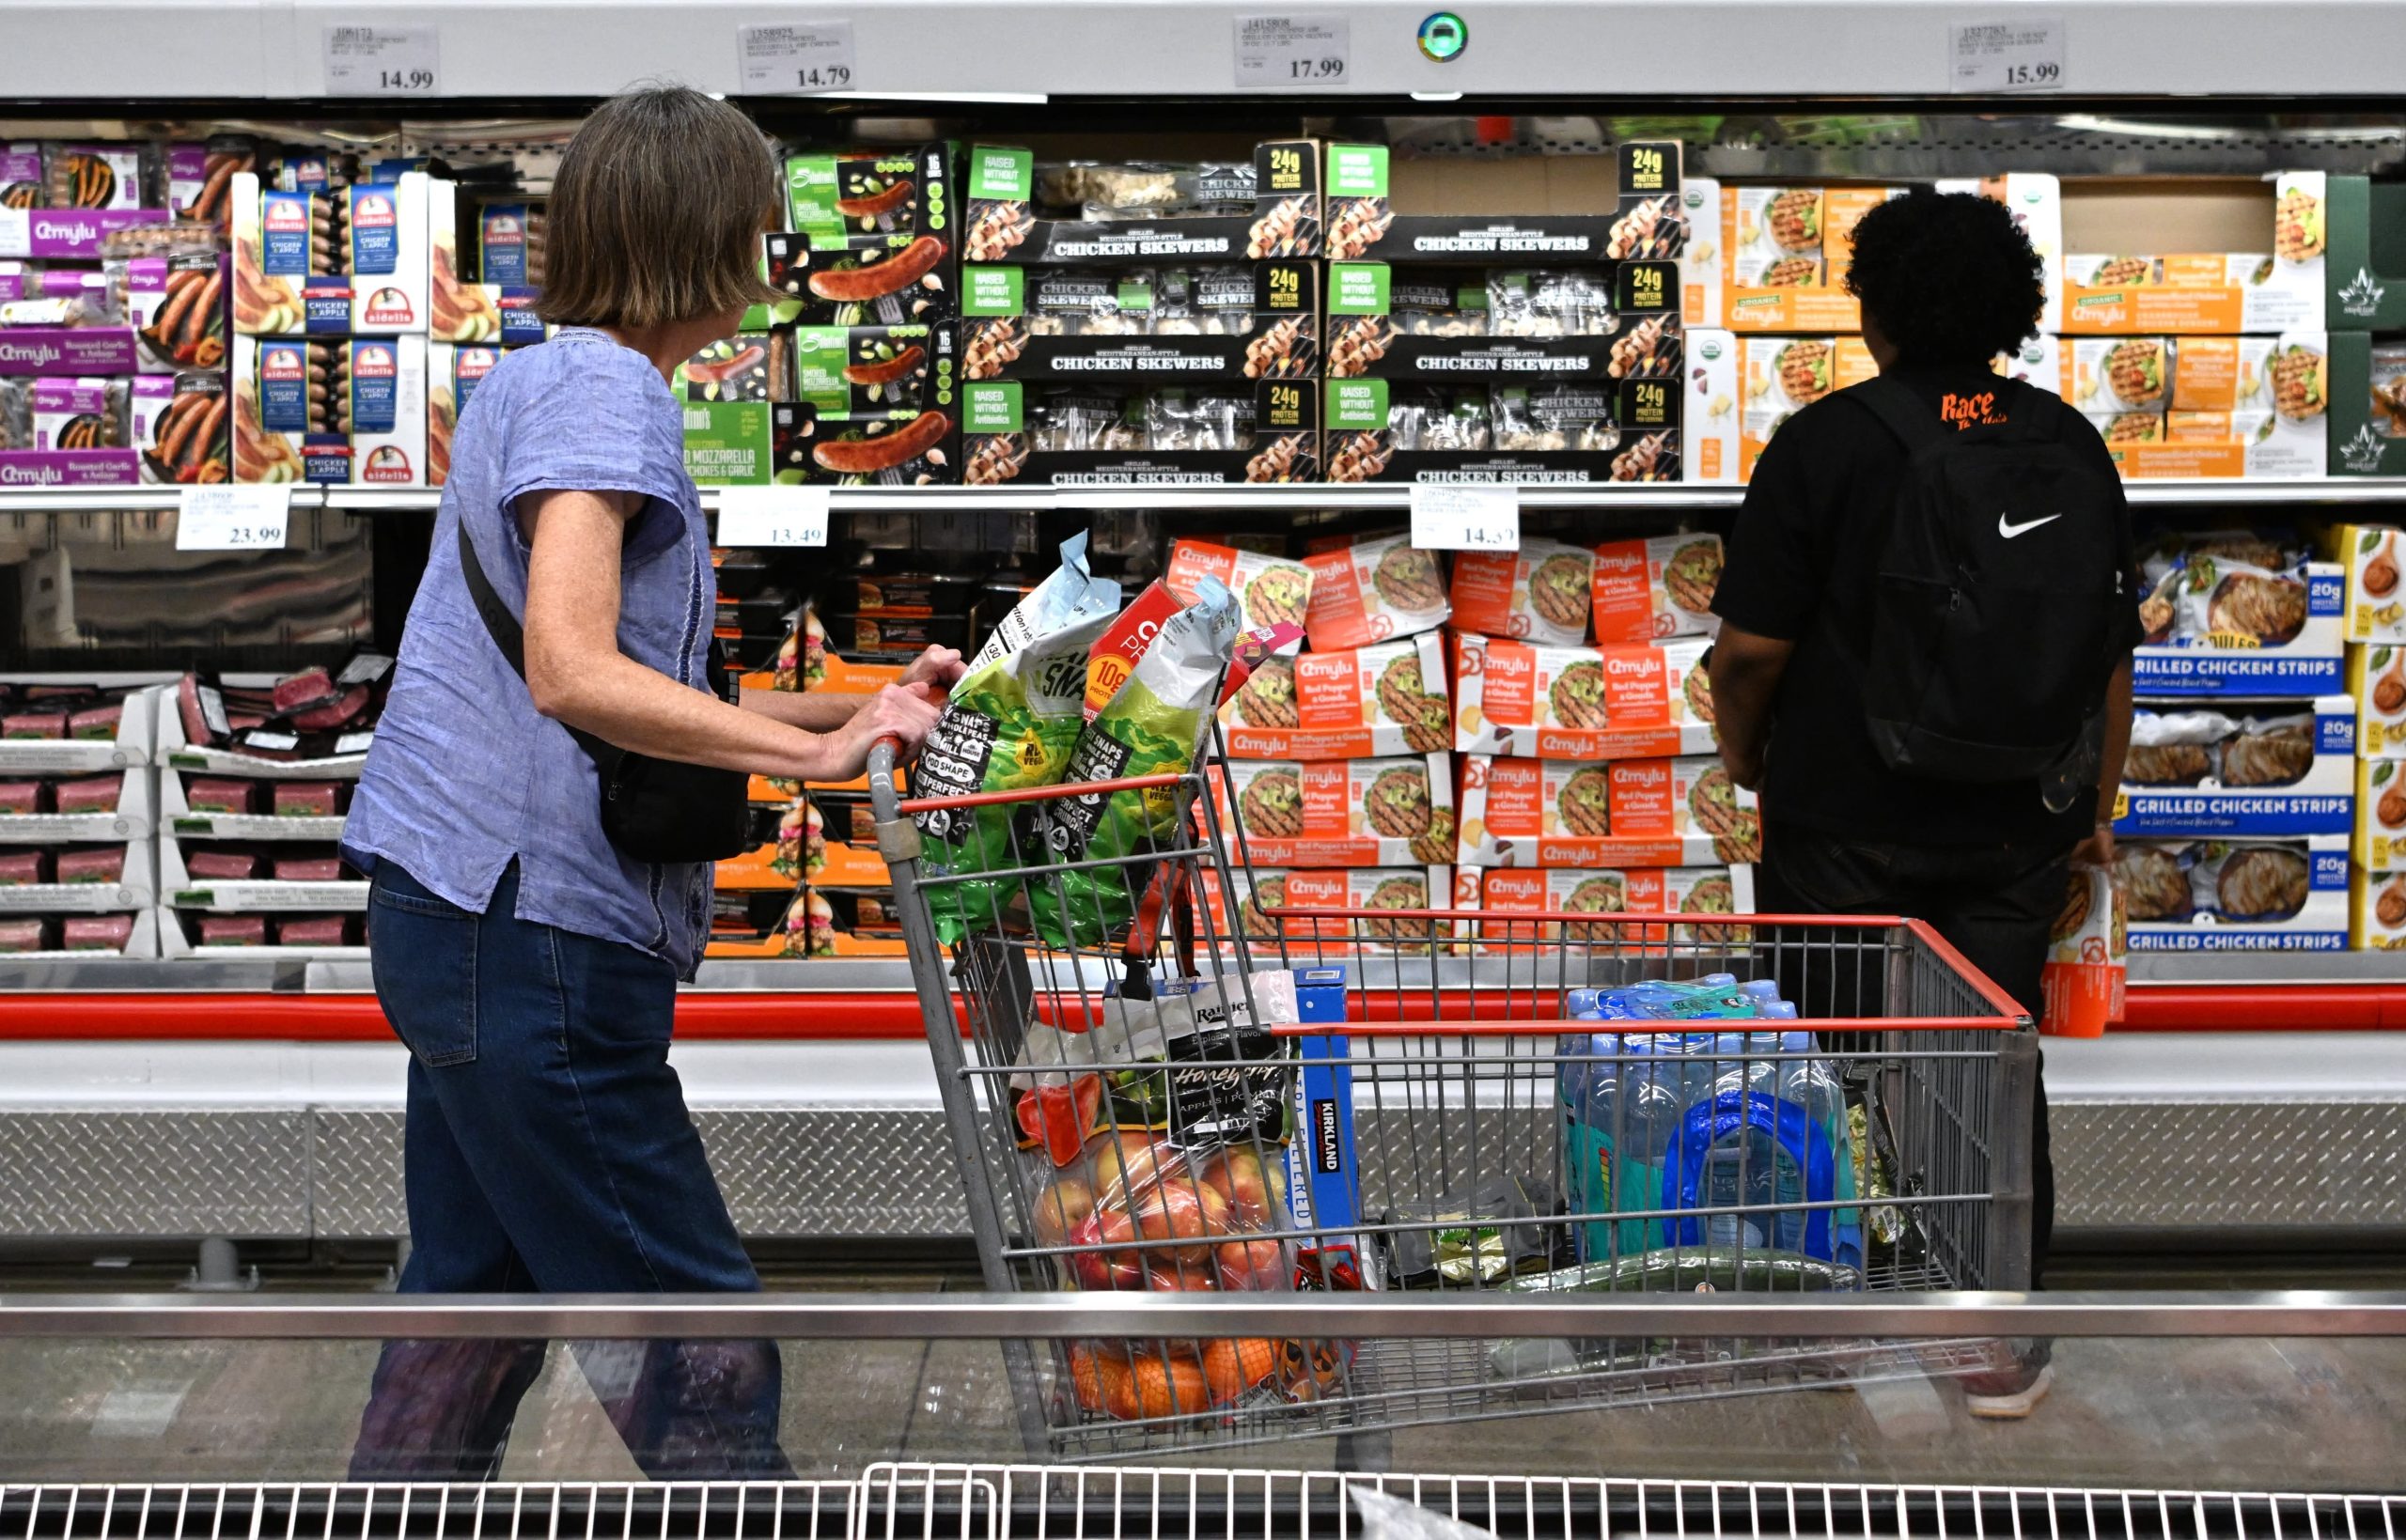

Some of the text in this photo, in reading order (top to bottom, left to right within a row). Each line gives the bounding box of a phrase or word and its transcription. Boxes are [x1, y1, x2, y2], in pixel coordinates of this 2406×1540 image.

[1289, 59, 1344, 78] 17.99
[2007, 64, 2060, 84] 15.99
[381, 70, 434, 88] 14.99
[797, 67, 851, 86] 14.79
[928, 156, 940, 170] 16
[985, 157, 1015, 168] RAISED
[1271, 150, 1300, 173] 24g
[1633, 149, 1663, 172] 24g
[984, 169, 1019, 180] WITHOUT
[1273, 175, 1300, 183] PROTEIN
[1633, 174, 1662, 182] PROTEIN
[1055, 238, 1229, 257] CHICKEN SKEWERS
[1414, 237, 1589, 252] CHICKEN SKEWERS
[1270, 270, 1298, 291] 24g
[1633, 268, 1662, 290] 24g
[975, 286, 1010, 296] WITHOUT
[1040, 284, 1107, 294] CHICKEN
[1199, 283, 1255, 293] CHICKE
[1270, 293, 1298, 302] PROTEIN
[1633, 292, 1662, 301] PROTEIN
[308, 302, 349, 310] CHICKEN
[938, 331, 950, 345] 16
[1052, 357, 1225, 370] CHICKEN SKEWERS
[1415, 357, 1589, 371] CHICKEN SKEWERS
[269, 390, 300, 398] CHICKEN
[359, 386, 391, 395] CHICKEN
[974, 391, 1004, 401] RAISED
[1271, 386, 1299, 409] 24g
[1339, 387, 1370, 397] RAISED
[1636, 384, 1664, 406] 24g
[974, 403, 1008, 413] WITHOUT
[1339, 399, 1375, 409] WITHOUT
[1537, 397, 1603, 408] CHICKEN
[1941, 391, 1994, 422] Race
[1535, 408, 1606, 418] SKEWERS
[1635, 408, 1664, 416] PROTEIN
[307, 459, 348, 467] CHICKEN
[693, 449, 756, 464] MOZZARELLA
[318, 466, 347, 474] APPLE
[366, 471, 412, 480] aidells
[686, 465, 720, 476] ICHOKES
[728, 465, 756, 476] GARLIC
[1415, 471, 1589, 482] CHICKEN SKEWERS
[1052, 474, 1225, 485] CHICKEN SKEWERS
[229, 528, 281, 543] 23.99
[772, 528, 821, 543] 13.49
[2311, 583, 2340, 599] 20g
[988, 643, 1001, 659] 130
[2134, 659, 2336, 675] RILLED CHICKEN STRIPS
[1042, 662, 1086, 700] SNA
[1097, 660, 1127, 693] 10g
[1089, 684, 1116, 701] PROTE
[1304, 683, 1353, 694] Red Pepper
[1629, 680, 1660, 691] Pepper
[952, 712, 991, 733] SNAPS
[968, 726, 989, 741] PEAS
[1611, 731, 1640, 741] Pepper
[2323, 722, 2353, 739] 20g
[1093, 733, 1123, 760] SNAPS
[1305, 735, 1336, 744] Pepper
[962, 748, 980, 757] HOUSE
[927, 755, 969, 779] POD SHAPE
[1101, 752, 1117, 769] PEAS
[1304, 770, 1343, 788] mylu
[1505, 791, 1535, 801] Pepper
[1633, 791, 1664, 802] Pepper
[1060, 798, 1093, 824] ERFECT
[2134, 799, 2348, 815] GRILLED CHICKEN STRIPS
[1310, 842, 1340, 852] Pepper
[1615, 844, 1645, 854] Pepper
[2317, 858, 2346, 874] 20g
[2128, 934, 2341, 950] GRILLED CHICKEN STRIPS
[1235, 1030, 1261, 1039] Flavor
[1321, 1102, 1337, 1171] KIRKLAND
